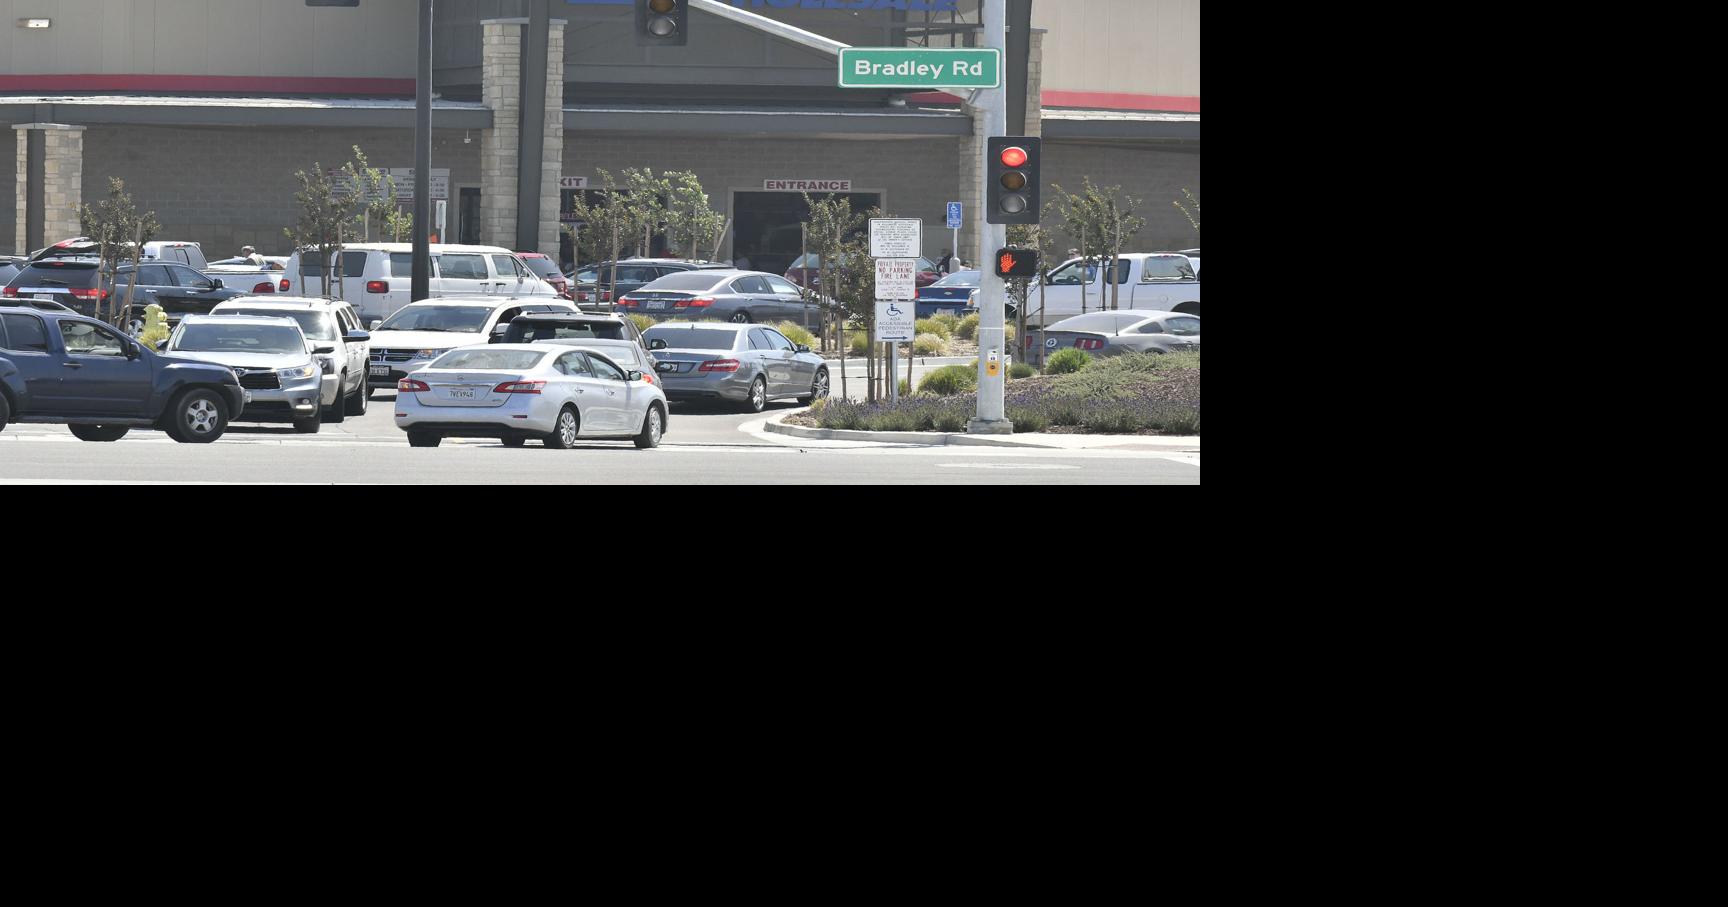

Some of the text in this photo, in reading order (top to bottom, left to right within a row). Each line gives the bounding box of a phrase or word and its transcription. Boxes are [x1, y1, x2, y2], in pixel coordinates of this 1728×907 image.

[855, 59, 983, 79] Bradley Rd
[560, 177, 583, 187] XIT
[766, 180, 849, 190] ENTRANCE
